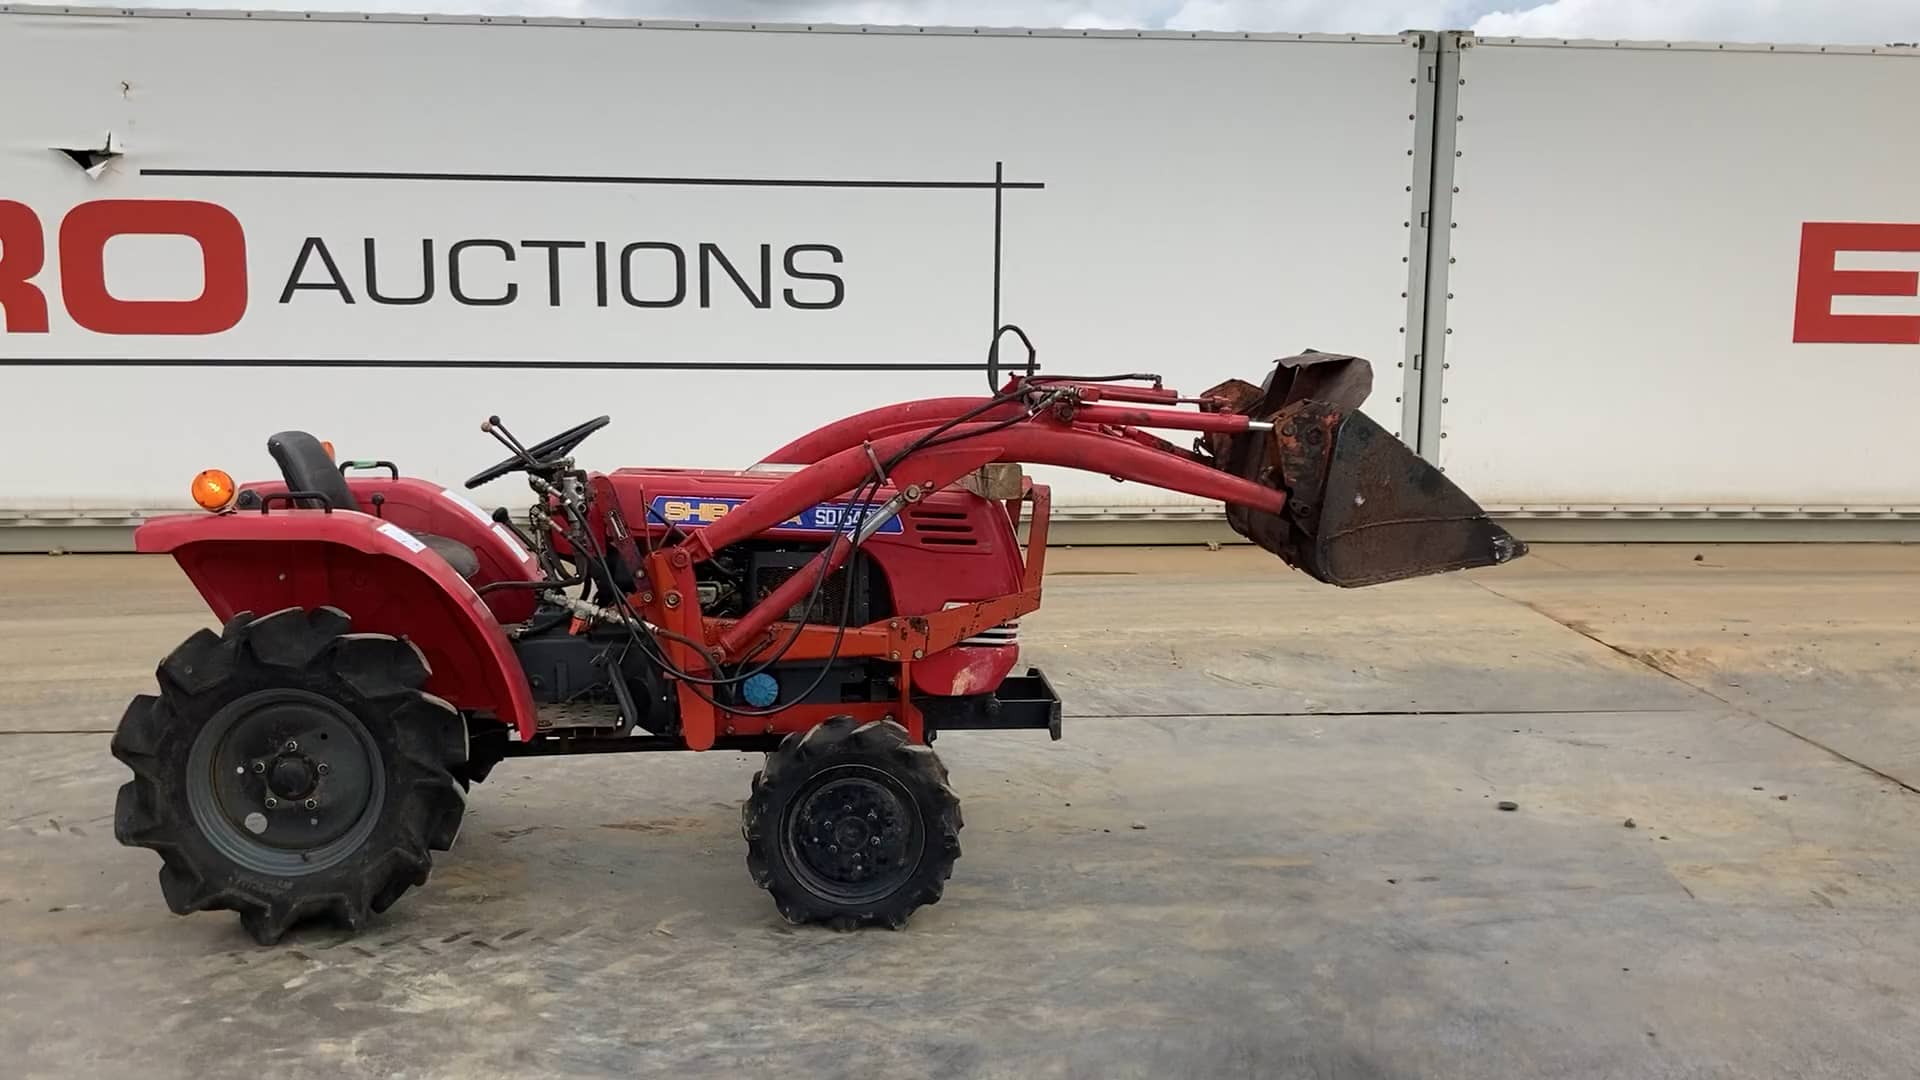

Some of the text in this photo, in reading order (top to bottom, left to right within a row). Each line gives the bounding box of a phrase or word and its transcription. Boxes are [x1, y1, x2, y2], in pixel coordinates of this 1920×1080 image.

[0, 199, 845, 335] O AUCTIONS
[1792, 222, 1920, 344] E
